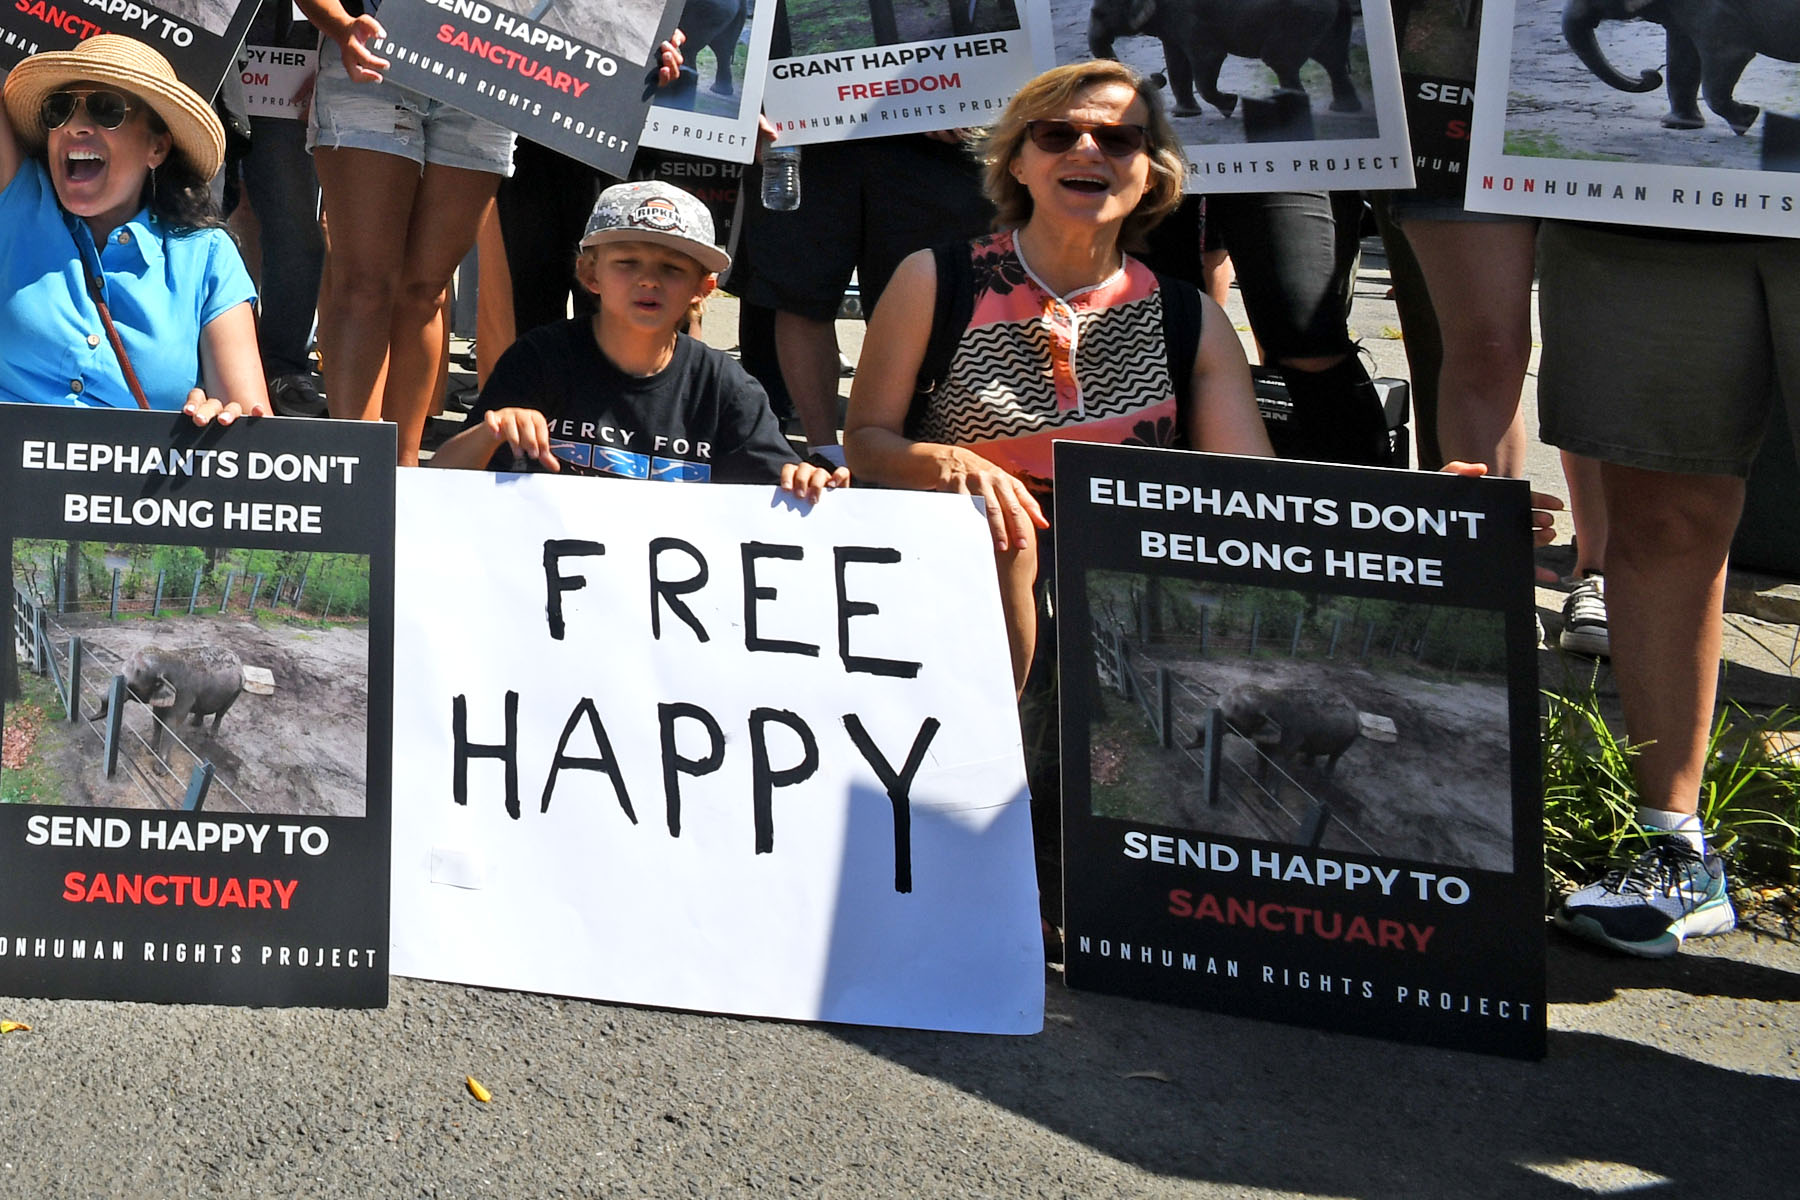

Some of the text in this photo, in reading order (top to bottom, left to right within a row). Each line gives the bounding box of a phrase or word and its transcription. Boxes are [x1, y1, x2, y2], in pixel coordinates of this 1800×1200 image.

[159, 14, 194, 49] TO
[493, 13, 582, 62] HAPPY
[584, 49, 618, 77] TO
[270, 52, 306, 67] HER
[436, 23, 590, 99] SANCTUARY
[772, 37, 1008, 80] GRANT HAPPY HER
[373, 36, 631, 152] NONHUMAN RIGHTS PROJECT
[837, 72, 962, 101] FREEDOM
[1418, 82, 1474, 105] SEN
[672, 124, 748, 147] PROJECT
[776, 97, 1003, 132] NONHUMAN RIGHTS PROJ
[661, 161, 716, 177] SEND
[1190, 159, 1275, 175] RIGHTS
[1292, 155, 1399, 173] PROJECT
[1483, 176, 1793, 212] NONHUMAN RIGHTS
[638, 207, 682, 225] RIPKEN
[22, 440, 360, 484] ELEPHANTS DON'T
[653, 435, 712, 459] FOR
[64, 493, 322, 535] BELONG HERE
[1089, 477, 1486, 540] ELEPHANTS DON'T
[1140, 531, 1444, 588] BELONG HERE
[543, 537, 923, 678] FREE
[452, 690, 941, 894] HAPPY
[25, 814, 329, 856] SEND HAPPY TO
[1122, 829, 1470, 906] SEND HAPPY TO
[62, 871, 298, 909] SANCTUARY
[1168, 888, 1436, 955] SANCTUARY
[144, 942, 242, 965] RIGHTS
[262, 945, 377, 969] PROJECT
[1080, 934, 1532, 1022] NONHUMAN RIGHTS PROJECT
